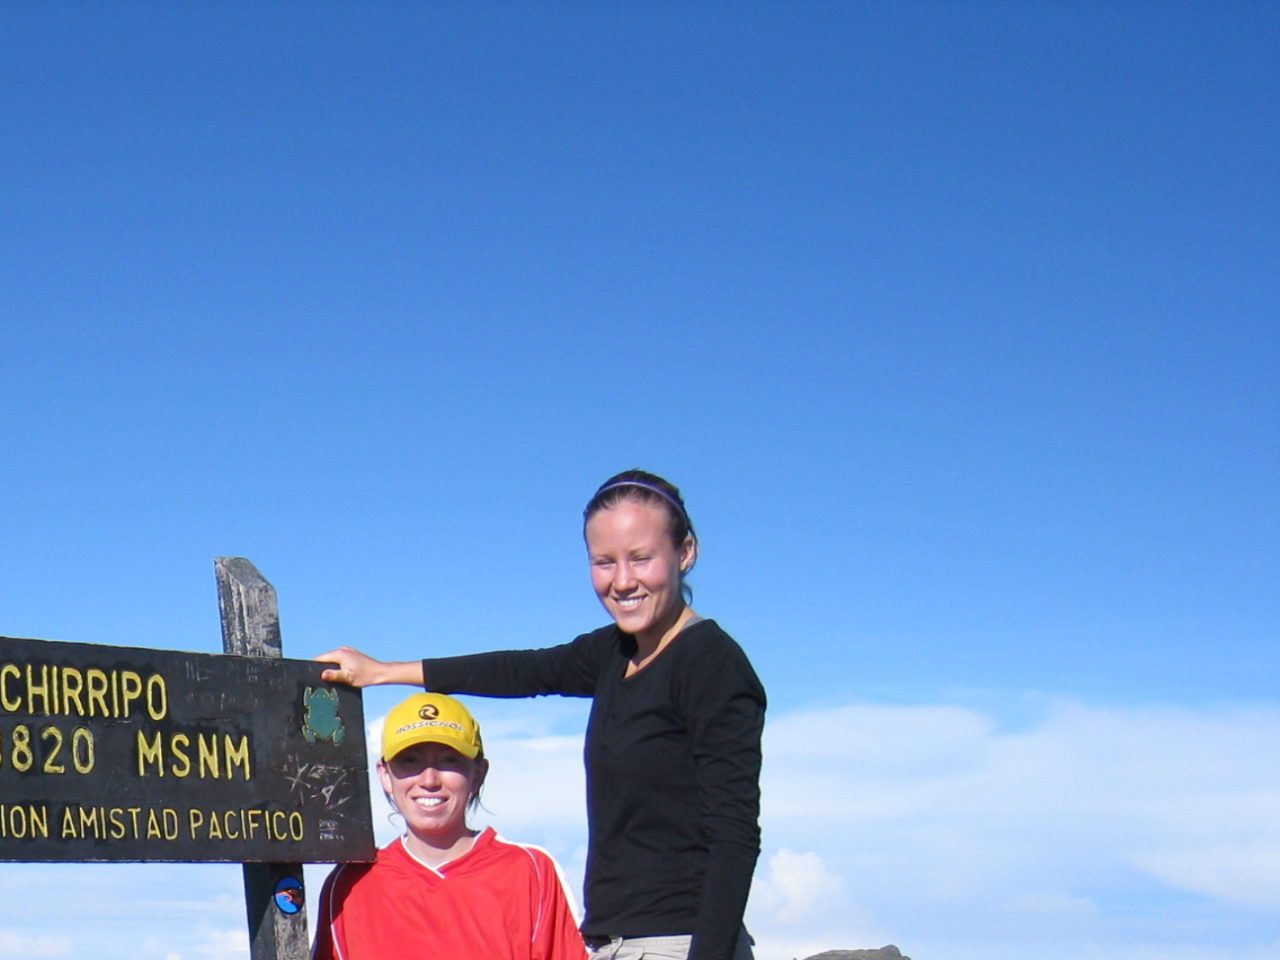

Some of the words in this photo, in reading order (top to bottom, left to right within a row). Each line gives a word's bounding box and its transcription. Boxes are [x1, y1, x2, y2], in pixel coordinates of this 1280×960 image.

[0, 664, 168, 721] CHIRRIPO
[136, 729, 252, 781] MSNM
[61, 805, 180, 841] AMISTAD
[189, 808, 304, 842] PACIFICO
